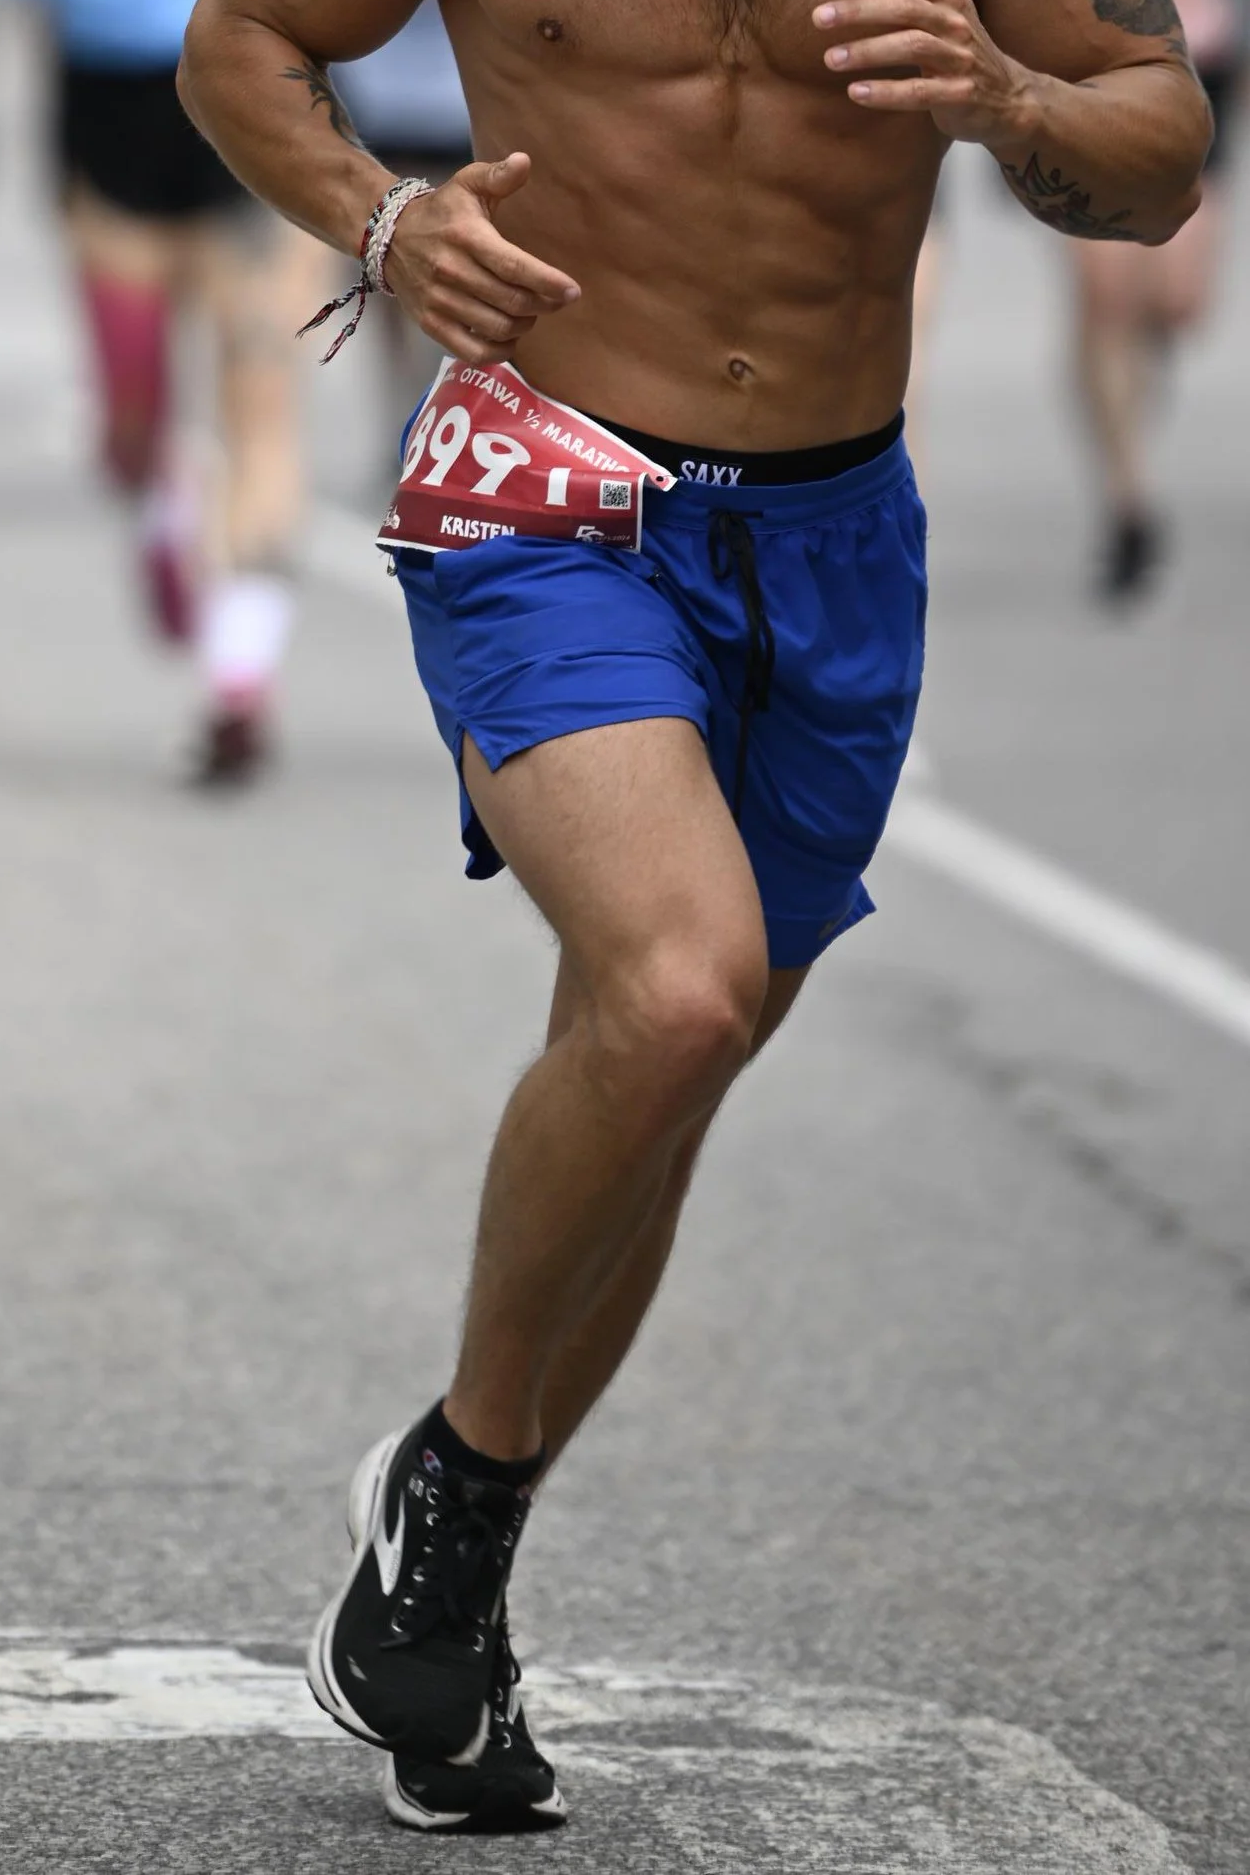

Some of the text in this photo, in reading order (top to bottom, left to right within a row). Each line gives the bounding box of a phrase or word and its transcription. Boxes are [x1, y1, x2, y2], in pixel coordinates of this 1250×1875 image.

[459, 367, 521, 415] OTTAWA
[679, 460, 743, 487] SAXX
[440, 514, 516, 540] KRISTEN
